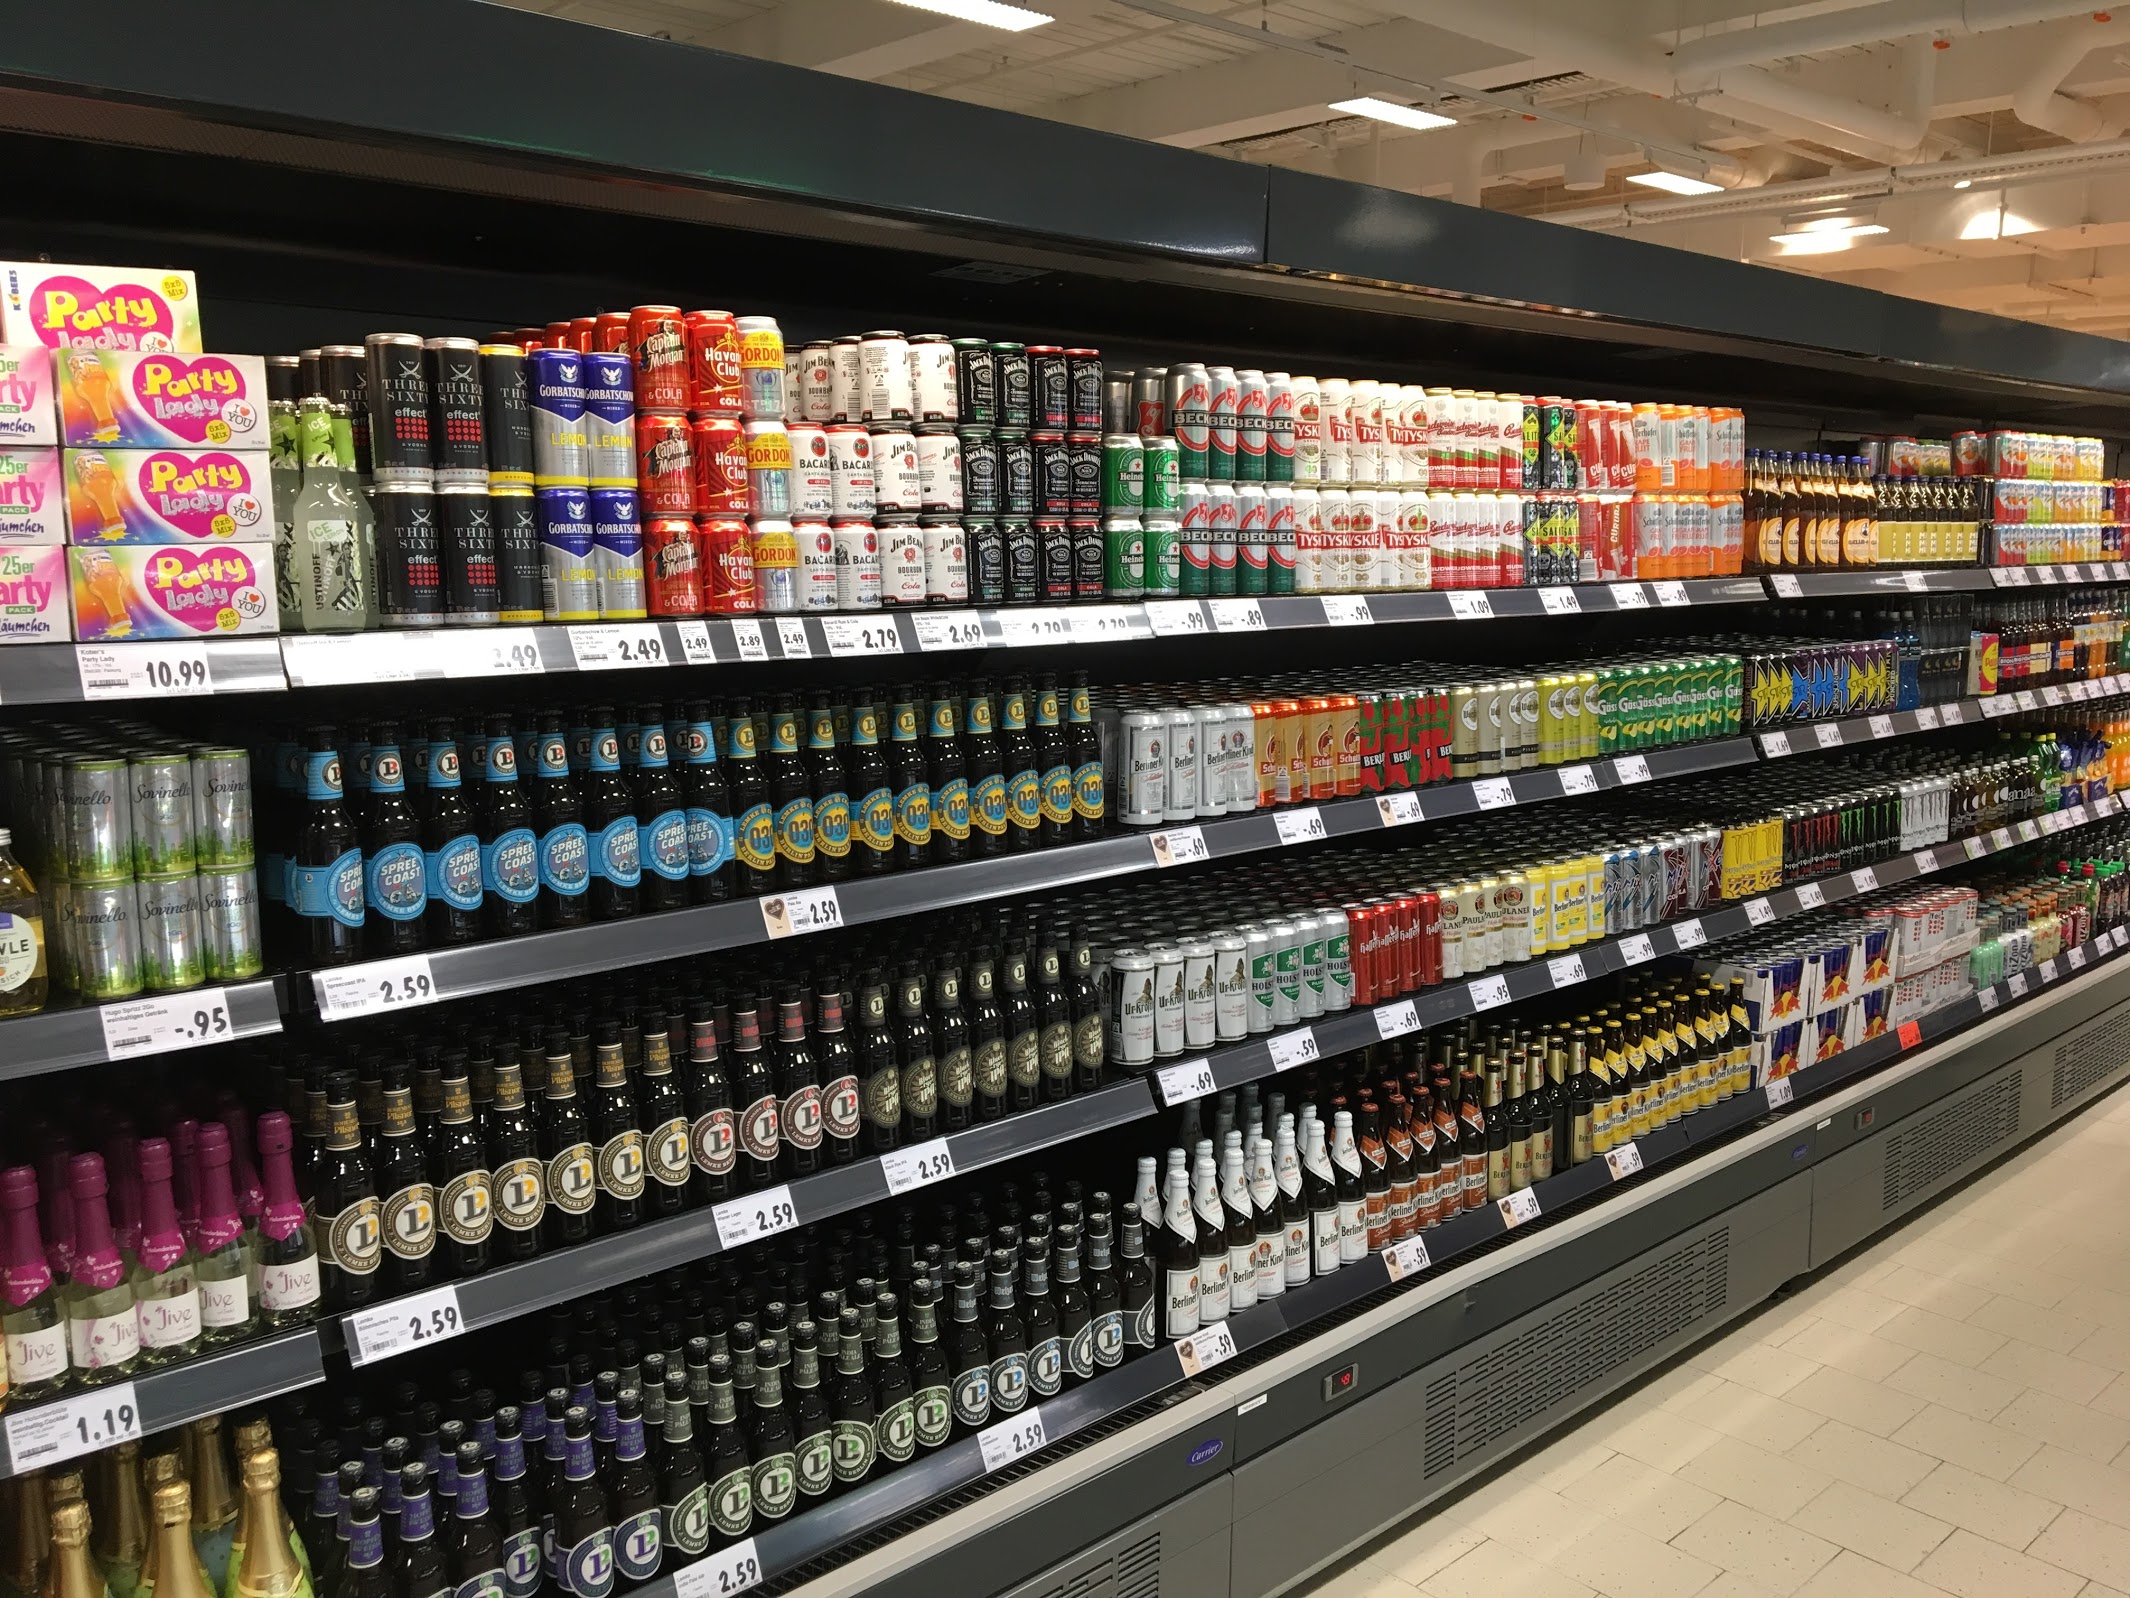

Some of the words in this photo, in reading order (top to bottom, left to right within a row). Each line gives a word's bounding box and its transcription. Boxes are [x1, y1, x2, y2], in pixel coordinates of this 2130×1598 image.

[167, 288, 184, 298] Mix
[43, 291, 158, 331] Party
[647, 333, 681, 353] Captain
[649, 351, 684, 372] Morgan
[717, 362, 740, 377] Club
[804, 356, 817, 374] JIM
[142, 363, 238, 397] Party
[655, 388, 682, 400] COLA
[720, 397, 742, 406] COLA
[227, 413, 252, 428] YOU
[395, 408, 427, 418] effect
[447, 410, 479, 420] effect
[308, 416, 327, 432] ICE
[211, 431, 228, 441] Mix
[594, 435, 632, 448] LEMON
[965, 451, 980, 462] JACK
[1070, 455, 1083, 466] JACK
[657, 456, 691, 476] Morgan
[727, 467, 747, 480] Club
[148, 461, 243, 493] Party
[664, 493, 690, 505] COLA
[729, 501, 749, 510] COLA
[233, 508, 258, 522] YOU
[216, 525, 233, 535] Mix
[309, 522, 332, 538] ICE
[891, 536, 905, 552] JIM
[1074, 539, 1089, 550] JACK
[2, 556, 34, 574] 25er
[408, 555, 437, 564] effect
[467, 555, 494, 564] effect
[664, 558, 698, 574] Morgan
[154, 556, 248, 589] Party
[608, 568, 644, 581] LEMON
[731, 567, 753, 580] Club
[901, 581, 921, 590] Cola
[1559, 596, 1578, 610] 1.49
[1631, 592, 1647, 605] -.79
[1672, 588, 1688, 602] -.89
[237, 599, 262, 614] YOU
[734, 600, 755, 609] COLA
[1469, 600, 1490, 615] 1.09
[1180, 612, 1203, 630] -.99
[1240, 609, 1262, 626] -.89
[1349, 605, 1369, 621] -.99
[222, 618, 238, 628] Mix
[739, 634, 761, 647] 2.89
[784, 633, 804, 645] 2.49
[862, 628, 896, 648] 2.79
[949, 623, 981, 643] 2.69
[618, 638, 661, 660] 2.49
[685, 638, 707, 649] 2.49
[146, 660, 206, 688] 10.99
[1774, 739, 1789, 753] 1.69
[1634, 763, 1649, 777] -.99
[1580, 774, 1596, 788] -.79
[1496, 786, 1512, 801] -.79
[1406, 803, 1420, 818] -.69
[822, 812, 849, 837] 030
[1302, 818, 1322, 835] -.69
[500, 844, 533, 861] SPREE
[550, 837, 584, 855] SPREE
[554, 845, 586, 863] COAST
[1188, 838, 1204, 854] -.69
[448, 849, 479, 868] SPREE
[504, 853, 536, 870] COAST
[381, 860, 417, 877] SPREE
[384, 868, 421, 885] COAST
[809, 900, 836, 926] 2.59
[1638, 941, 1653, 956] -.99
[1569, 965, 1584, 979] -.69
[380, 975, 430, 1003] 2.59
[1492, 985, 1509, 1000] -.95
[144, 1009, 168, 1017] Getränk
[1399, 1012, 1417, 1028] -.69
[174, 1007, 226, 1038] -.95
[1296, 1038, 1315, 1057] -.59
[1190, 1072, 1212, 1091] -.69
[918, 1154, 949, 1179] 2.59
[1629, 1152, 1641, 1168] -.59
[1525, 1197, 1538, 1214] -.59
[499, 1210, 524, 1223] LEMKE
[756, 1203, 792, 1231] 2.59
[450, 1223, 476, 1236] LEMKE
[343, 1254, 369, 1266] LEMKE
[1413, 1247, 1427, 1264] -.59
[278, 1271, 312, 1294] Jive
[200, 1286, 233, 1309] Jive
[156, 1306, 193, 1331] Jive
[409, 1306, 457, 1340] 2.59
[18, 1340, 57, 1365] Jive
[1215, 1334, 1230, 1356] -.59
[77, 1404, 134, 1444] 1.19
[1013, 1424, 1042, 1453] 2.59
[1191, 1442, 1219, 1463] Carrier
[719, 1558, 756, 1593] 2.59
